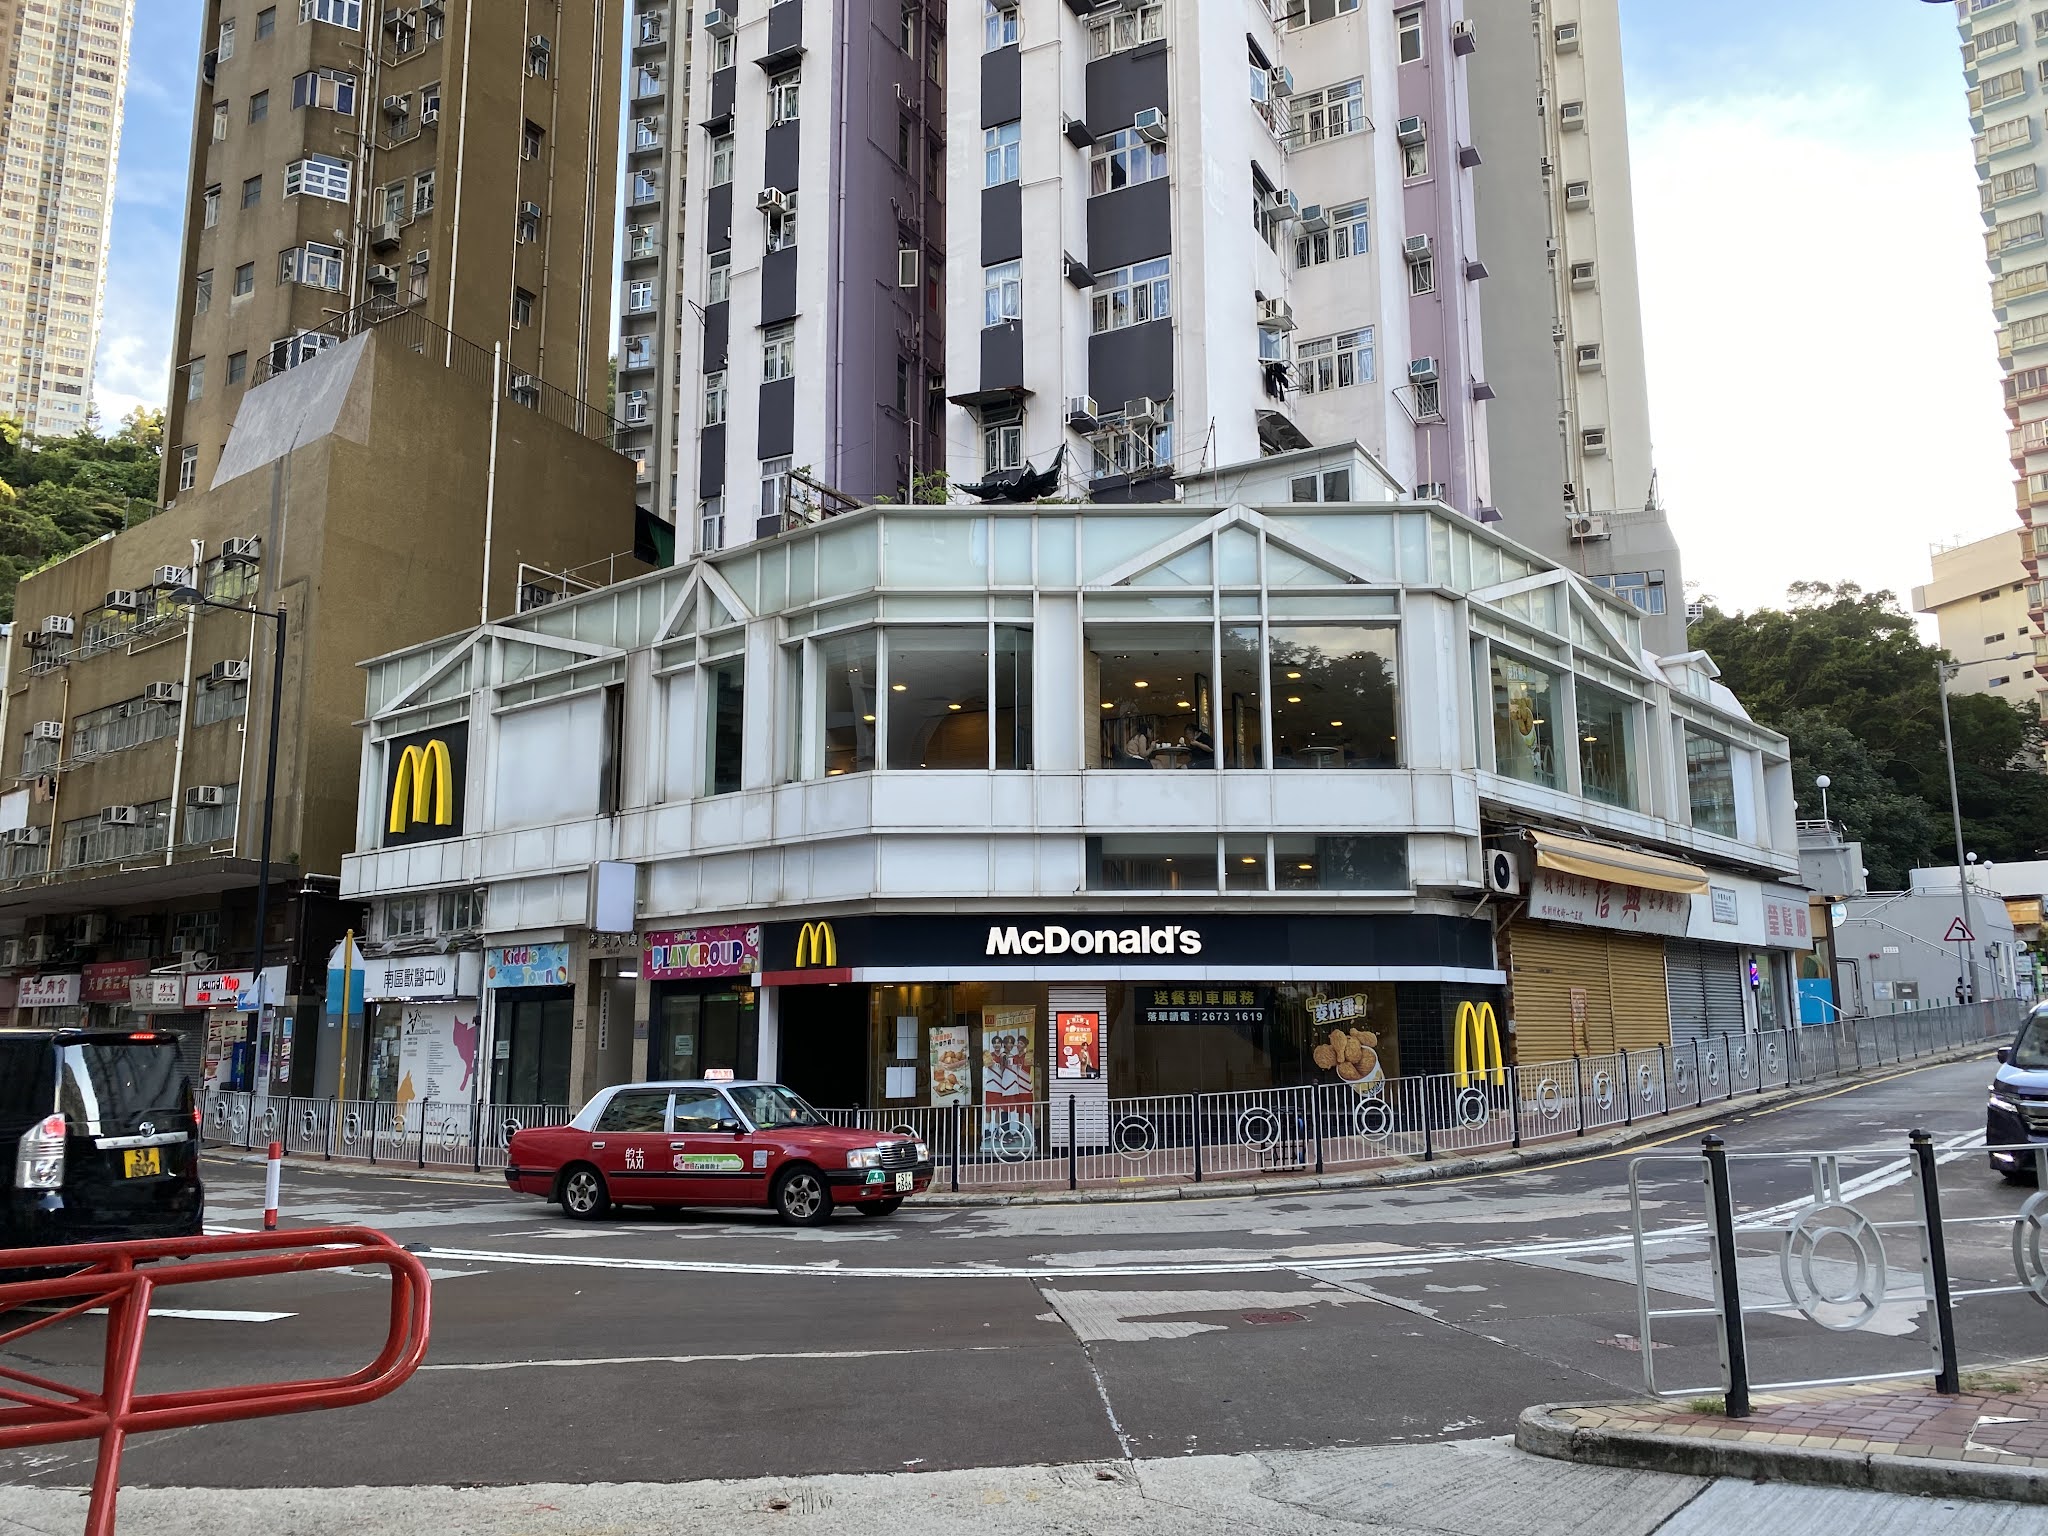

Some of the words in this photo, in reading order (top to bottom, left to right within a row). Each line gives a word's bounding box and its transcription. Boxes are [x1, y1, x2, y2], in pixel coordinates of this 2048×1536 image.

[985, 925, 1202, 955] McDonald's
[503, 945, 539, 966] Kiddie
[651, 940, 744, 970] PLAYGROUP
[383, 966, 446, 989] 南區獸醫中心
[522, 966, 554, 985] Town
[1153, 990, 1255, 1005] 送餐到車服務
[1201, 1011, 1230, 1021] 2673
[1235, 1011, 1263, 1021] 1619
[1315, 997, 1356, 1022] 麥炸雞
[625, 1147, 645, 1159] 的士
[625, 1158, 644, 1170] TAXI
